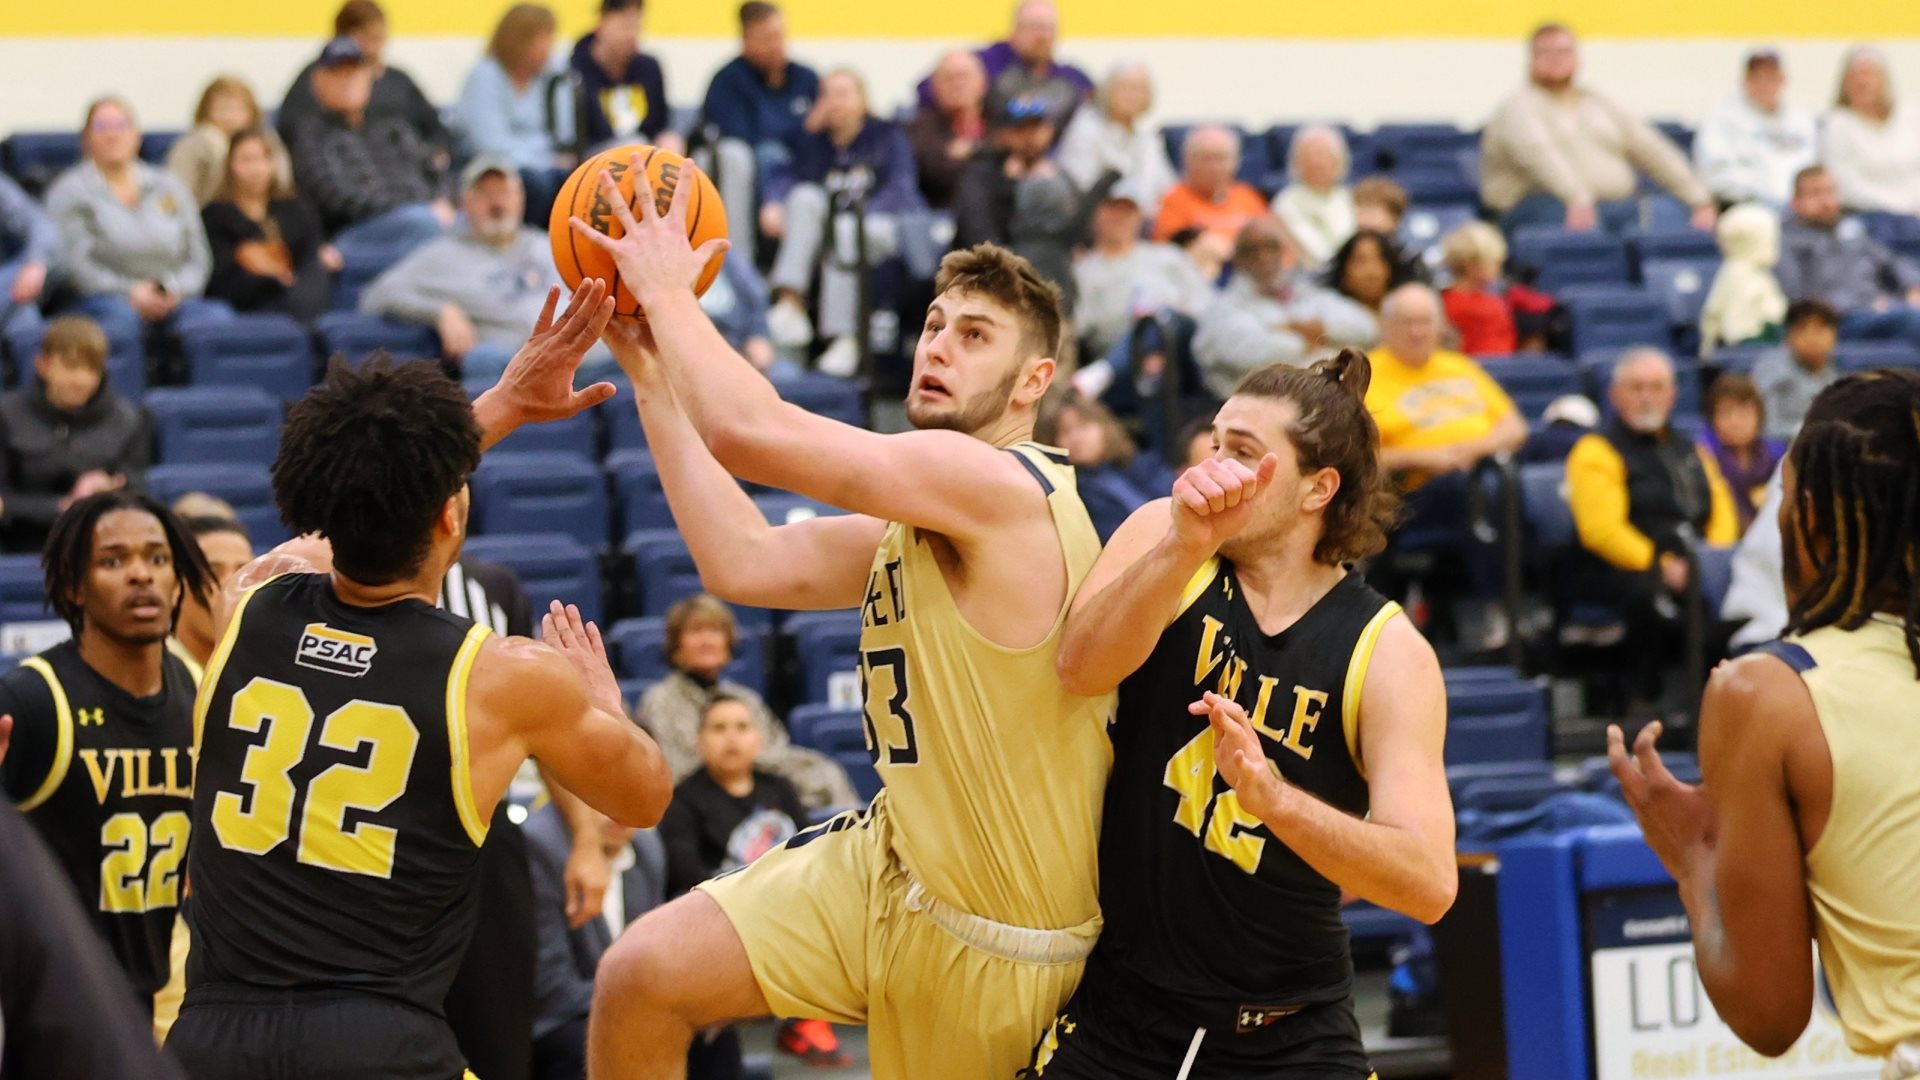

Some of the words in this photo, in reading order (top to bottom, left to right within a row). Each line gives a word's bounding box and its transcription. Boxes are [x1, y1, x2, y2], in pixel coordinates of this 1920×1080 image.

[590, 161, 629, 236] NAA
[301, 635, 374, 664] PSAC
[79, 747, 196, 805] VILL
[211, 676, 420, 879] 32
[1163, 724, 1283, 875] 42
[99, 810, 192, 913] 22
[1629, 956, 1700, 1031] LO
